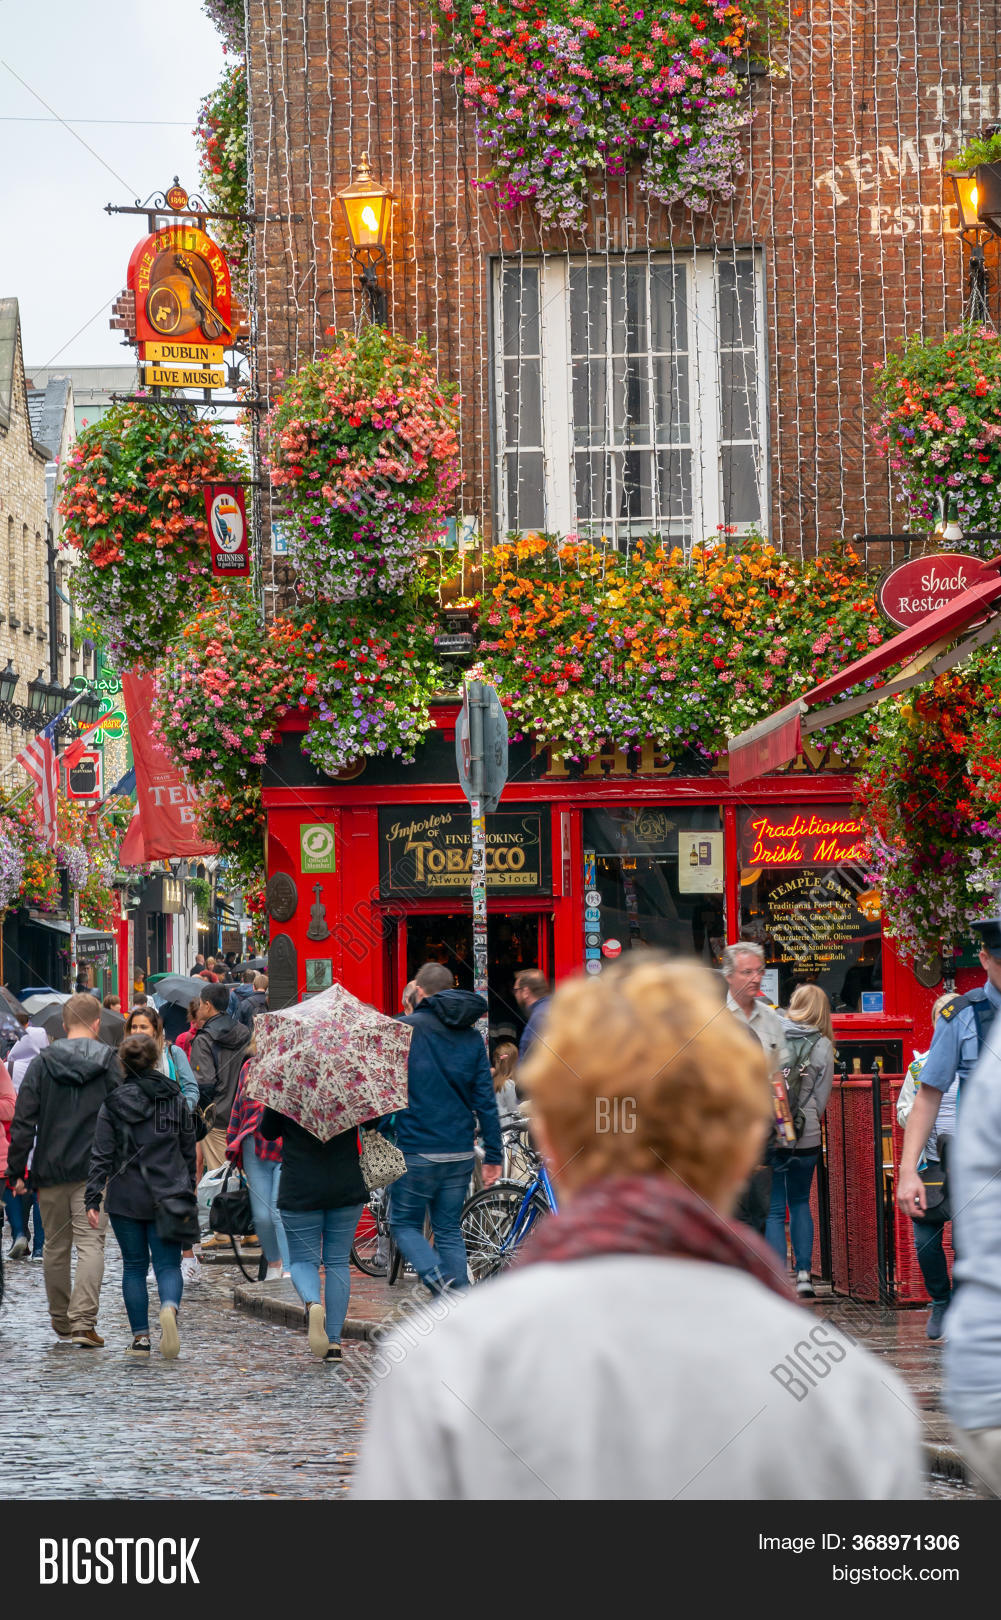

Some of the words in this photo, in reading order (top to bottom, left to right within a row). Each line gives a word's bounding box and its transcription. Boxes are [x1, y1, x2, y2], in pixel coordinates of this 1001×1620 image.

[926, 85, 1001, 120] TH
[814, 128, 968, 206] TEMP
[138, 252, 155, 294] THE
[208, 255, 227, 298] BAR
[161, 345, 209, 360] DUBLIN
[152, 370, 179, 384] LIVE
[182, 371, 219, 386] MUSIC
[216, 553, 244, 562] GUINNESS
[921, 566, 967, 593] Shack
[898, 596, 953, 613] Resta
[385, 812, 452, 842] Importers
[427, 829, 440, 838] OF
[445, 834, 471, 845] FINE
[485, 833, 525, 843] OKING
[750, 840, 802, 864] Irish
[813, 838, 864, 861] Musi
[430, 874, 472, 885] Alway
[500, 873, 536, 883] Stock
[768, 877, 822, 901] TEMPLE
[826, 880, 852, 900] BAR
[837, 922, 860, 930] Salmon
[782, 943, 806, 951] Toasted
[830, 952, 846, 960] Rolls
